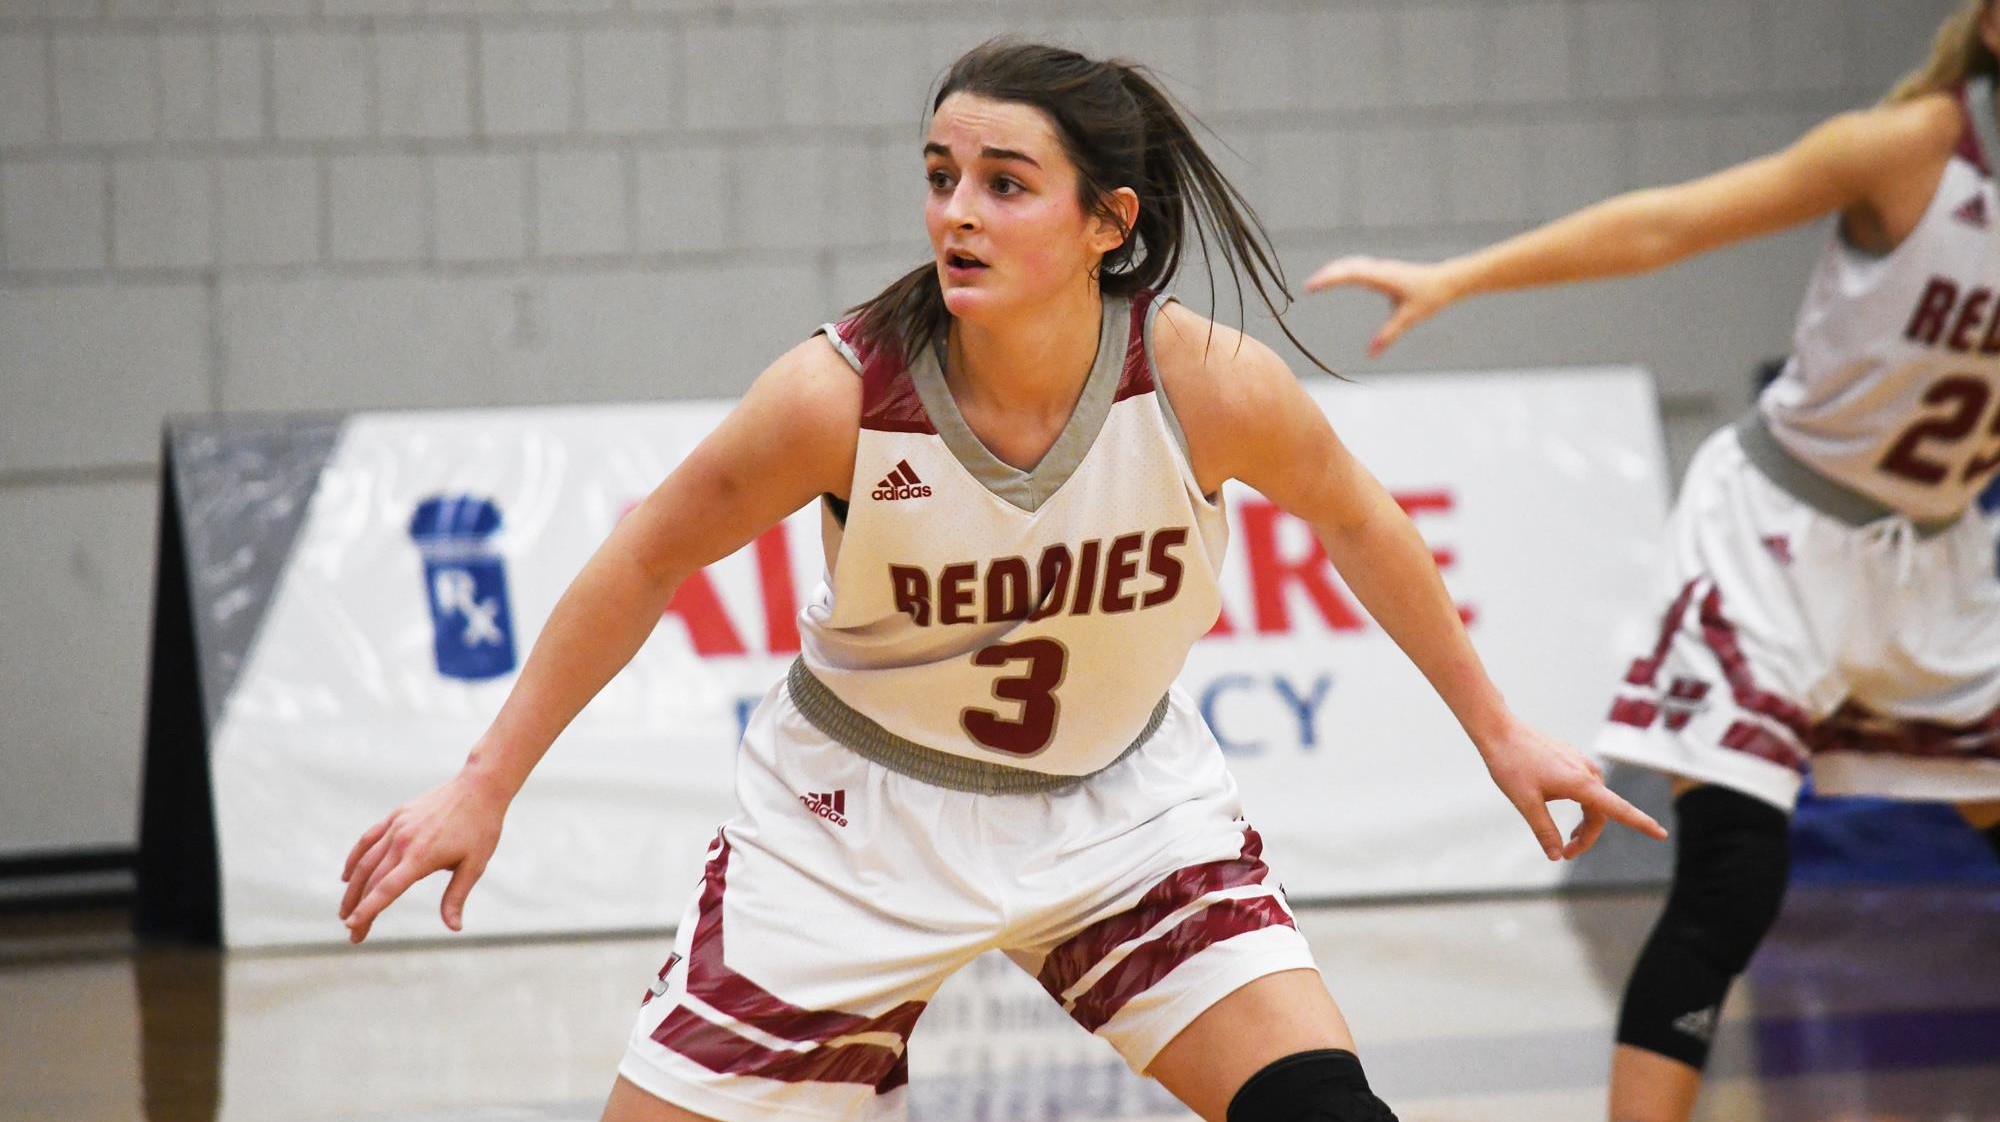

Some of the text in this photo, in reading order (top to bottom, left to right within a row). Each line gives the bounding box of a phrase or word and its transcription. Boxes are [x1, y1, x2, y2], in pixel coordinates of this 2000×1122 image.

[872, 484, 932, 501] adidas
[888, 526, 1189, 627] REDDIES
[959, 636, 1069, 759] 3
